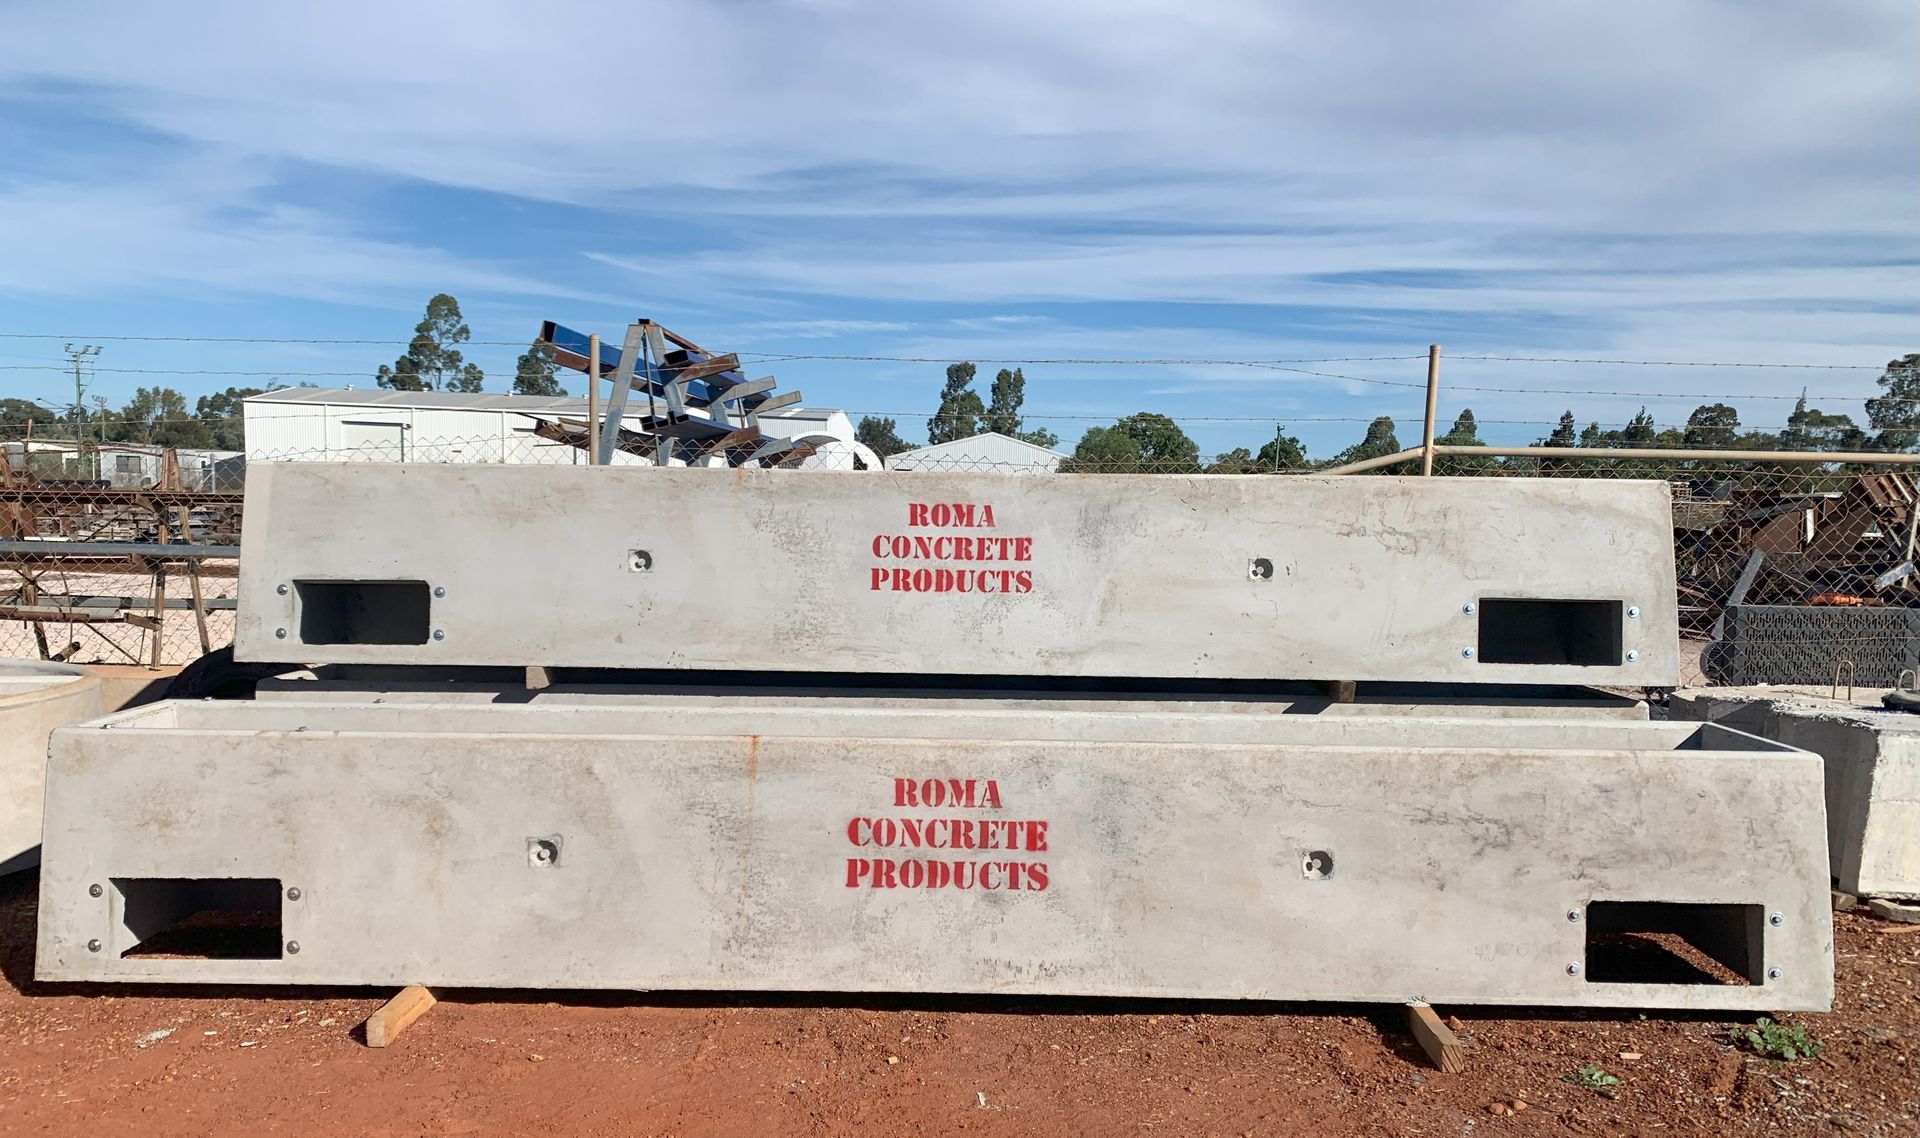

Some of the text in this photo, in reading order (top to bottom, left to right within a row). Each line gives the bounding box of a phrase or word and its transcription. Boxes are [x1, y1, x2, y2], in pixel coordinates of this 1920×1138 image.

[908, 502, 995, 528] ROMA
[873, 535, 1033, 561] CONCRETE
[871, 567, 1033, 593] PRODUCTS
[894, 778, 1002, 809] ROMA
[847, 817, 1049, 852] CONCRETE
[845, 858, 1049, 892] PRODUCTS
